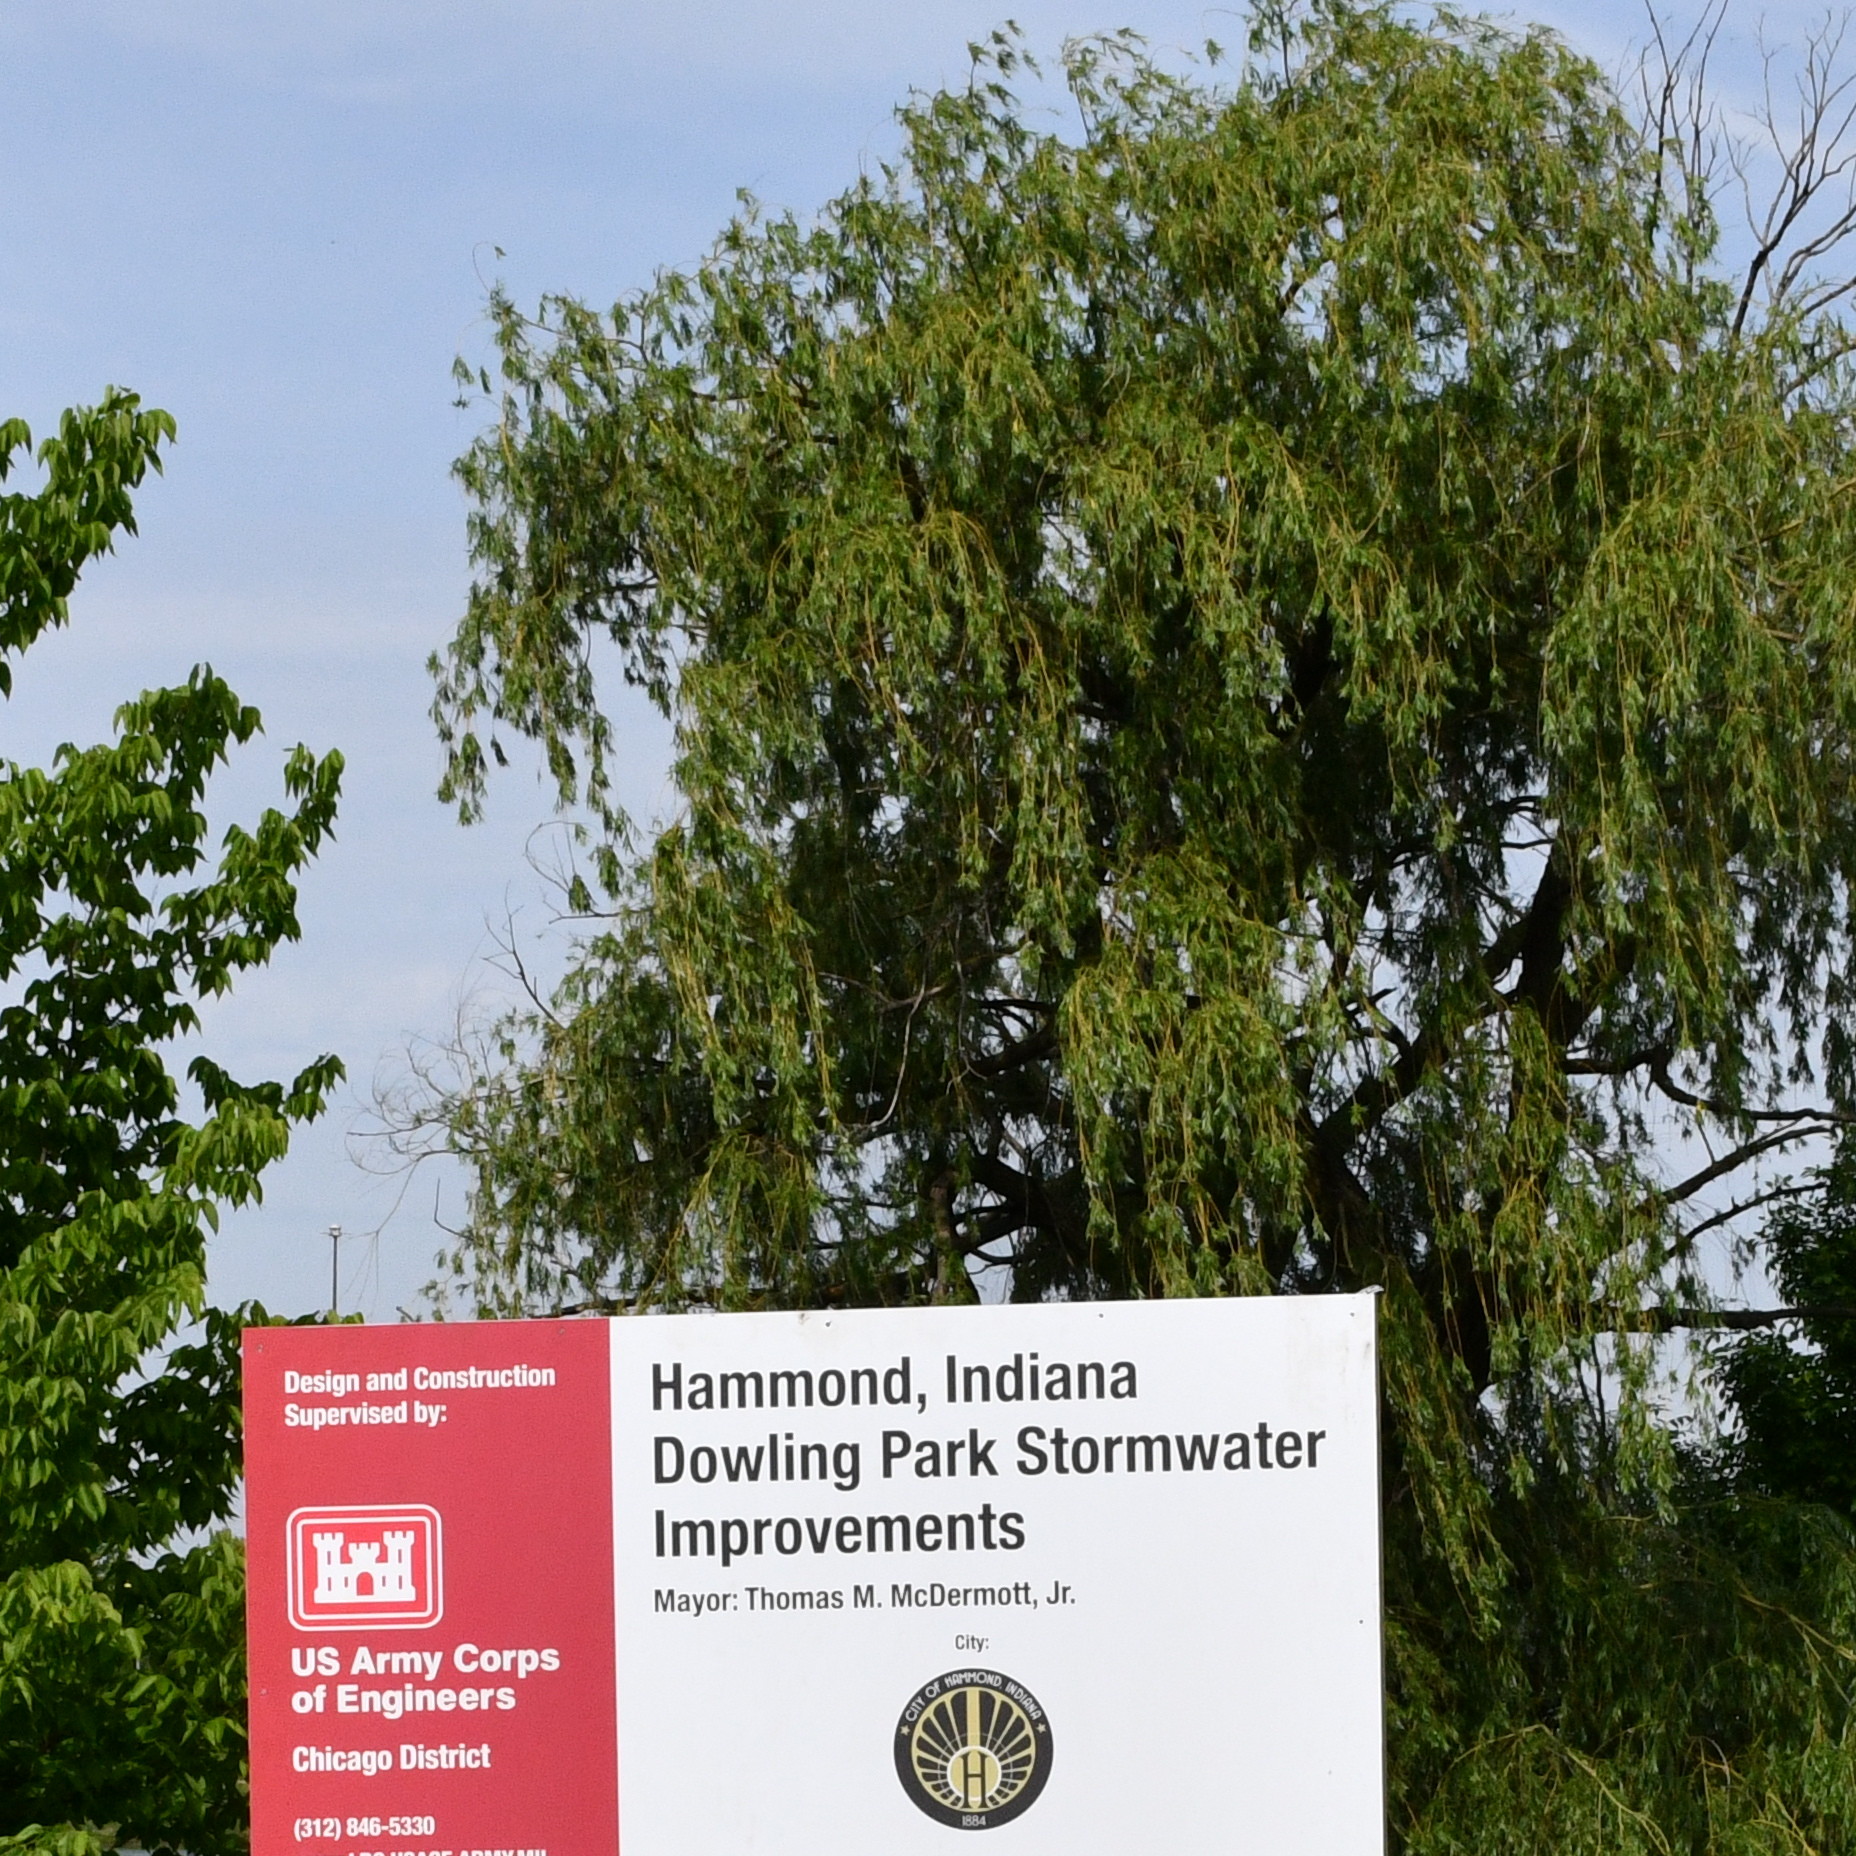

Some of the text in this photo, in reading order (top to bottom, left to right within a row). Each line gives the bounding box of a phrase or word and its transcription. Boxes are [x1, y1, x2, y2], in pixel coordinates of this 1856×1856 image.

[284, 1364, 556, 1398] Design and Construction
[650, 1351, 1139, 1415] Hammond, Indiana
[284, 1400, 448, 1431] Supervised by:
[652, 1421, 1328, 1493] Dowling Park Stormwater
[654, 1503, 1027, 1568] Improvements
[652, 1580, 1077, 1619] Mayor: Thomas M. McDermott, Jr.
[954, 1633, 990, 1654] City:
[291, 1643, 560, 1681] US Army Corps
[291, 1683, 516, 1719] of Engineers
[905, 1696, 927, 1722] CITY
[924, 1681, 942, 1698] OF
[1005, 1681, 1043, 1721] INDIANA
[292, 1743, 491, 1776] Chicago District
[294, 1815, 435, 1842] (312) 846-5330
[961, 1815, 987, 1828] 1884
